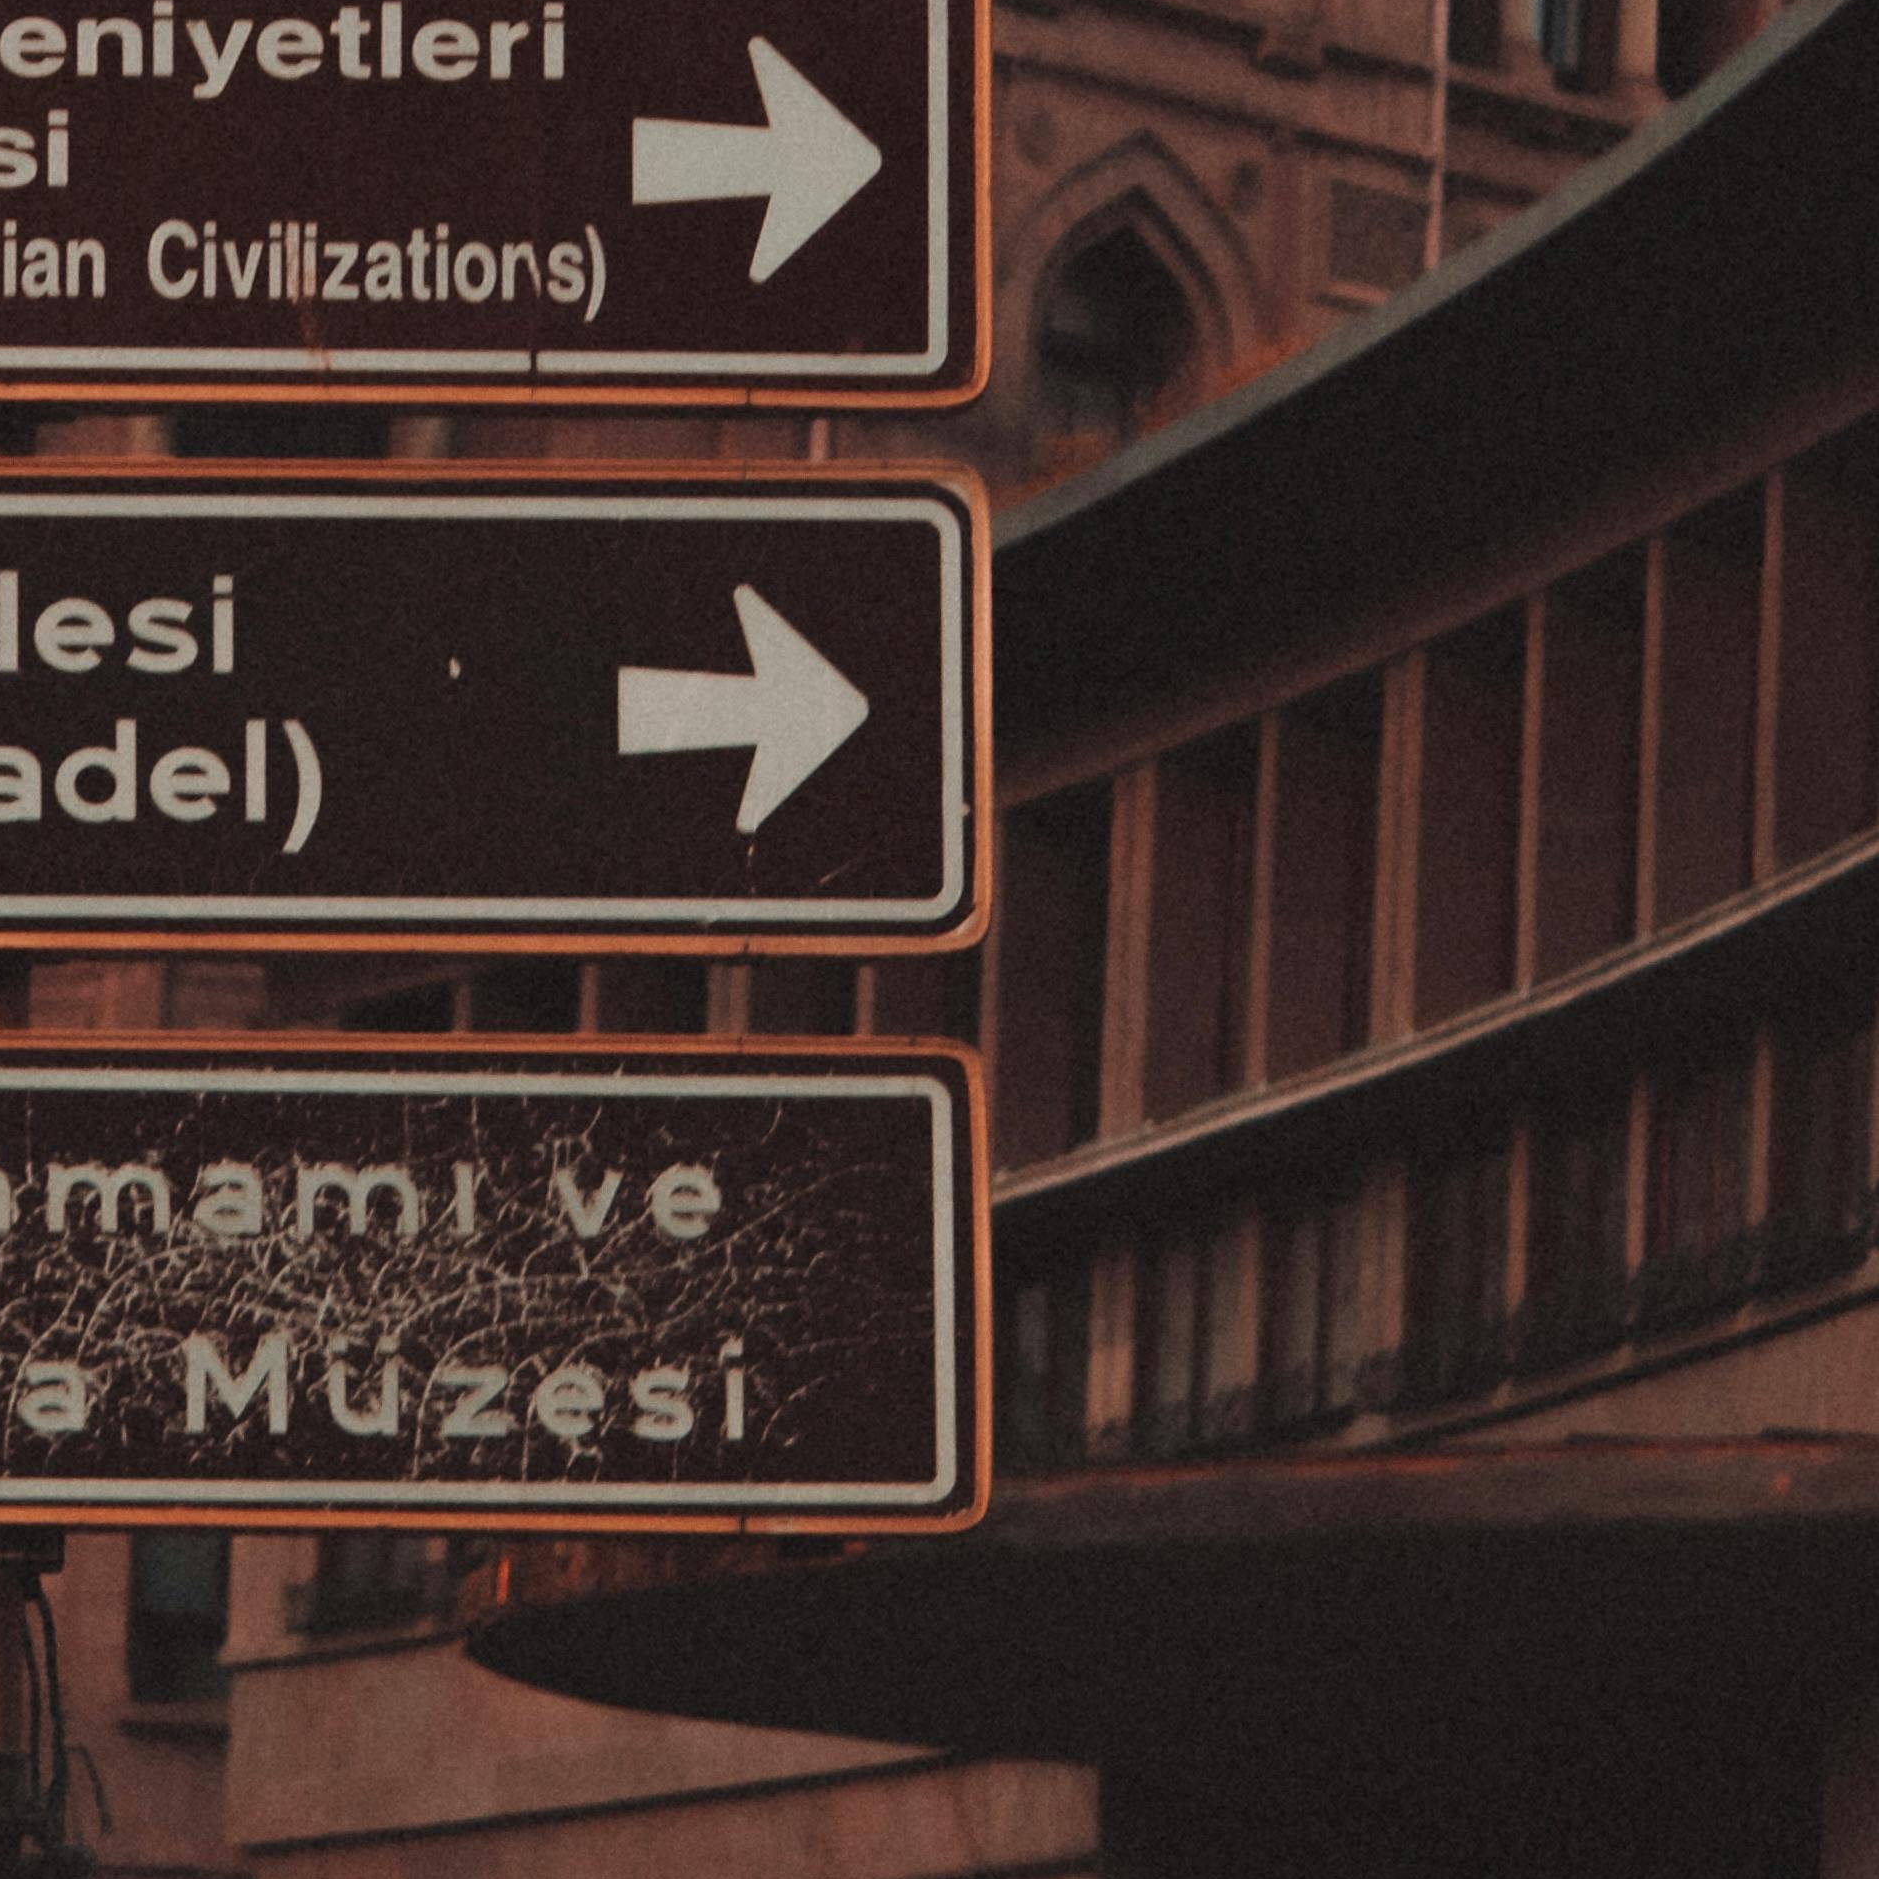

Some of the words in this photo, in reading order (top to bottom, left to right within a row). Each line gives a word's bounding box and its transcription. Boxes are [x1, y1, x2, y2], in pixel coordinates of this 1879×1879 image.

[148, 220, 606, 321] Civilizations)
[555, 1163, 721, 1239] ve
[184, 1333, 745, 1443] Müzesi
